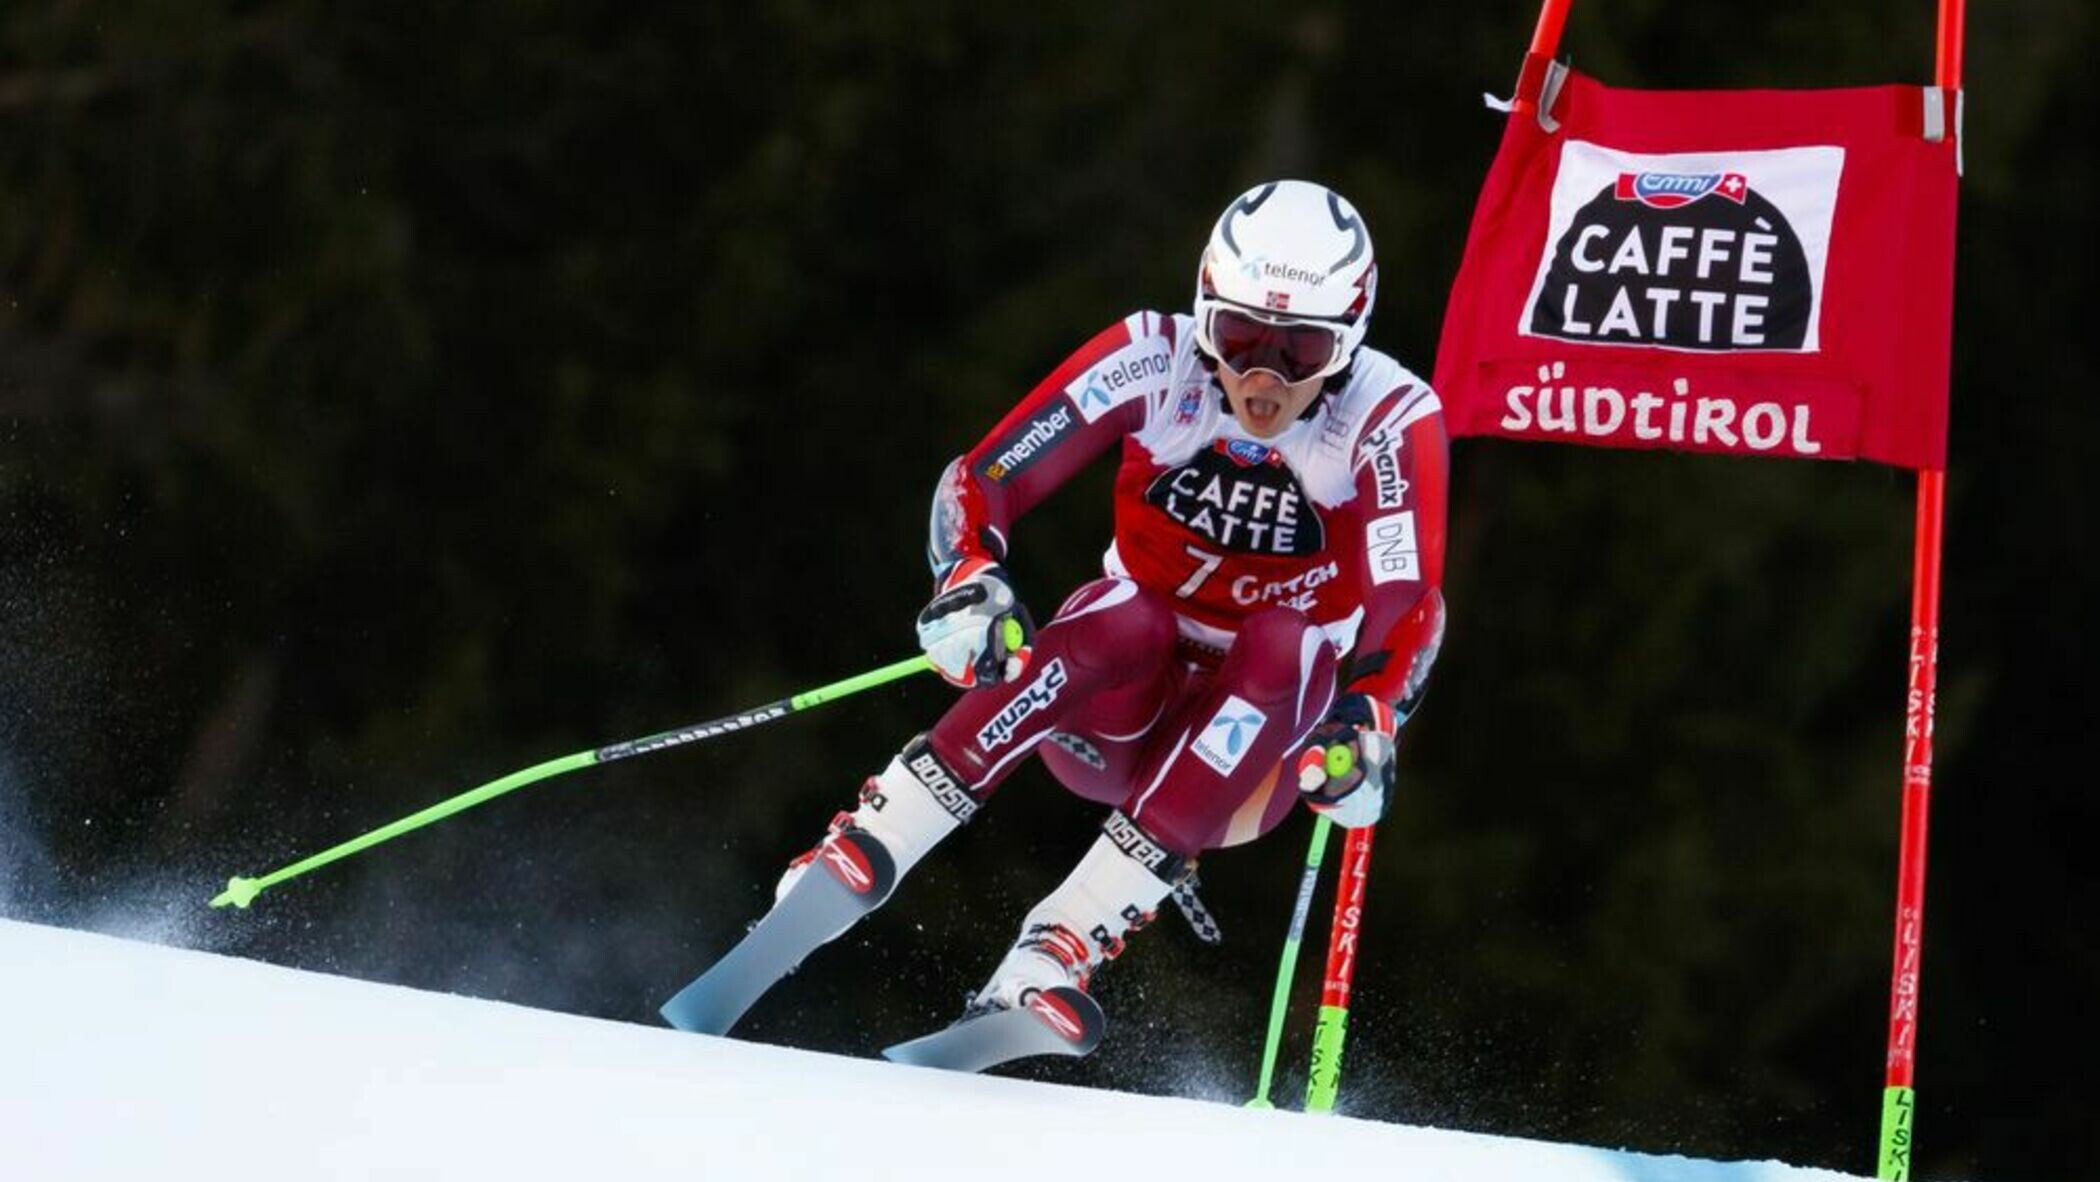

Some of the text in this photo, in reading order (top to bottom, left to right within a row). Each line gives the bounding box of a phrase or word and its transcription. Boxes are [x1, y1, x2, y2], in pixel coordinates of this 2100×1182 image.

[1263, 262, 1326, 287] telenor
[1570, 217, 1778, 284] CAFFÈ
[1562, 284, 1770, 345] LATTE
[1167, 493, 1297, 553] LATTE
[1171, 468, 1299, 526] CAFFÈ
[1175, 546, 1225, 598] 7
[1368, 522, 1419, 573] DNB
[981, 660, 1065, 747] phenix
[1336, 855, 1368, 979] LISKI
